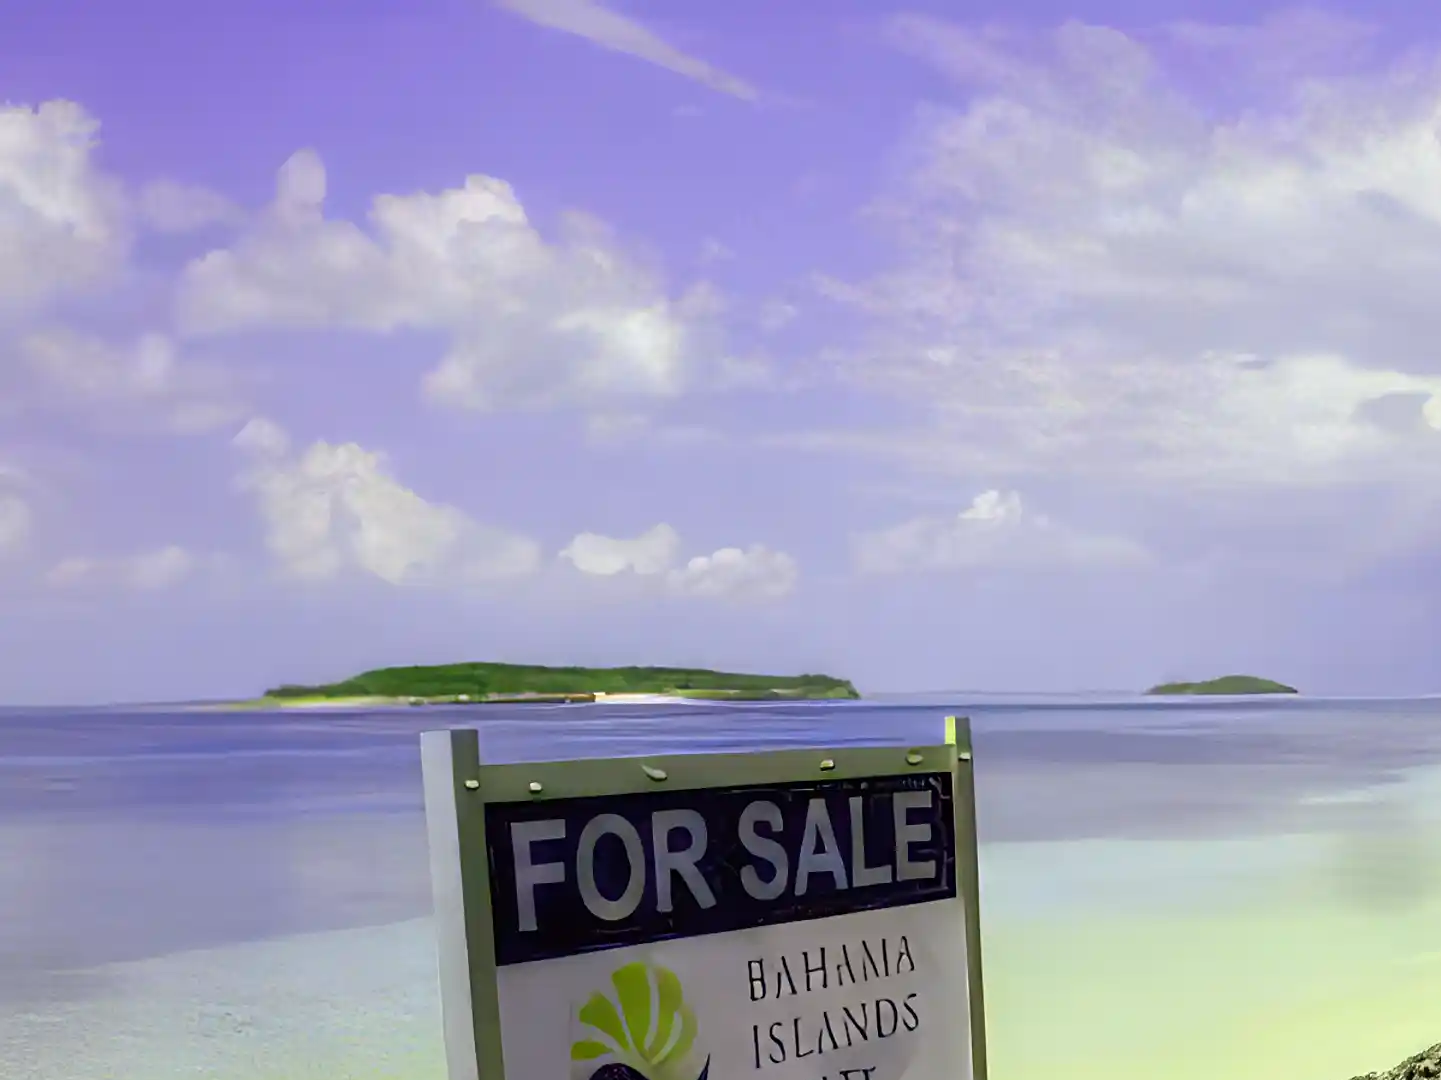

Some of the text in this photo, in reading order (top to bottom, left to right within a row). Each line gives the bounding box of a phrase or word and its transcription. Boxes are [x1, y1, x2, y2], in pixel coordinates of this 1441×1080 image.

[510, 790, 937, 932] FOR SALE
[748, 936, 915, 1001] BAHAMA
[753, 993, 919, 1068] ISLANDS
